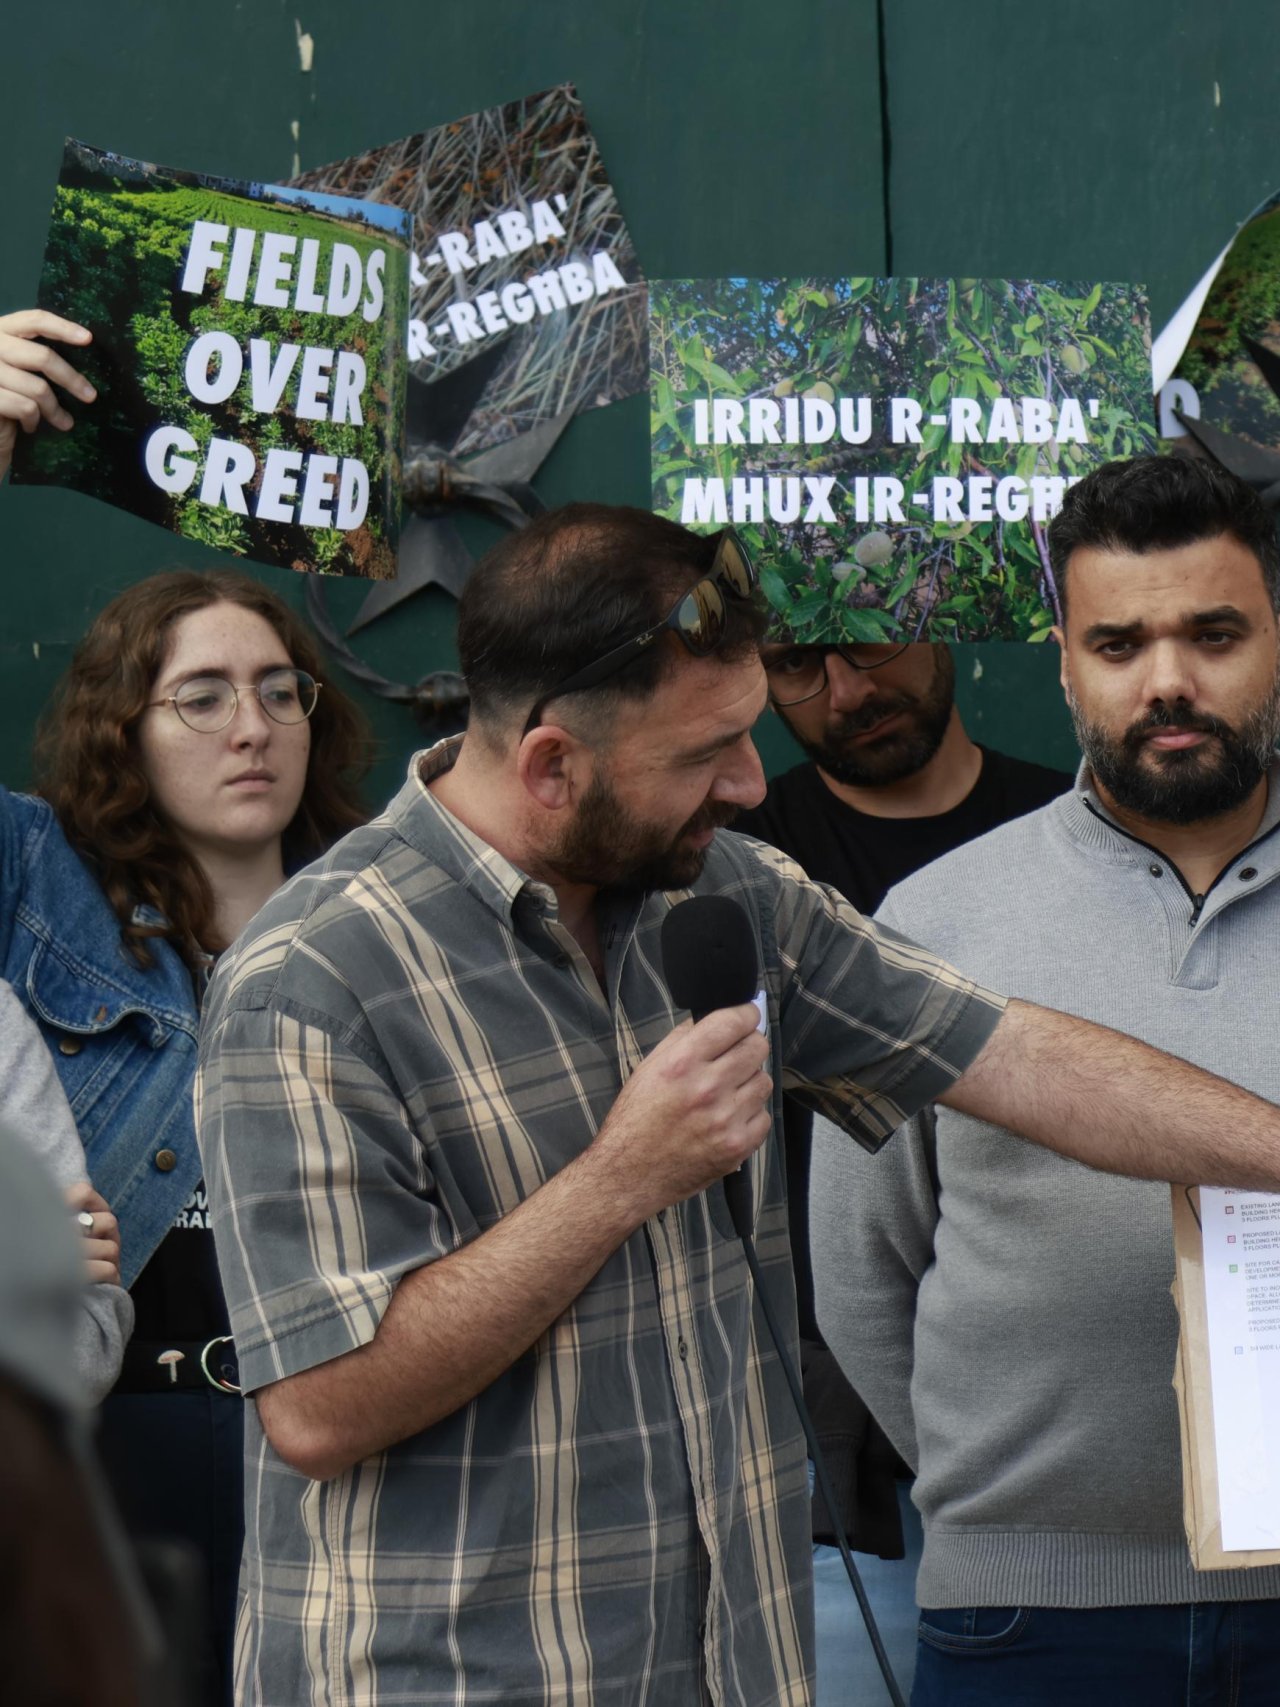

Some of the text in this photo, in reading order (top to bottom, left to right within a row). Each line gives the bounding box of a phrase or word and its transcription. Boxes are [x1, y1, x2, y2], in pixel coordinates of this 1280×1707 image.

[181, 220, 386, 323] FIELDS
[185, 330, 367, 426] OVER
[694, 398, 1099, 445] IRRIDU R-RABA'
[145, 425, 370, 531] GREED
[681, 477, 838, 524] MHUX
